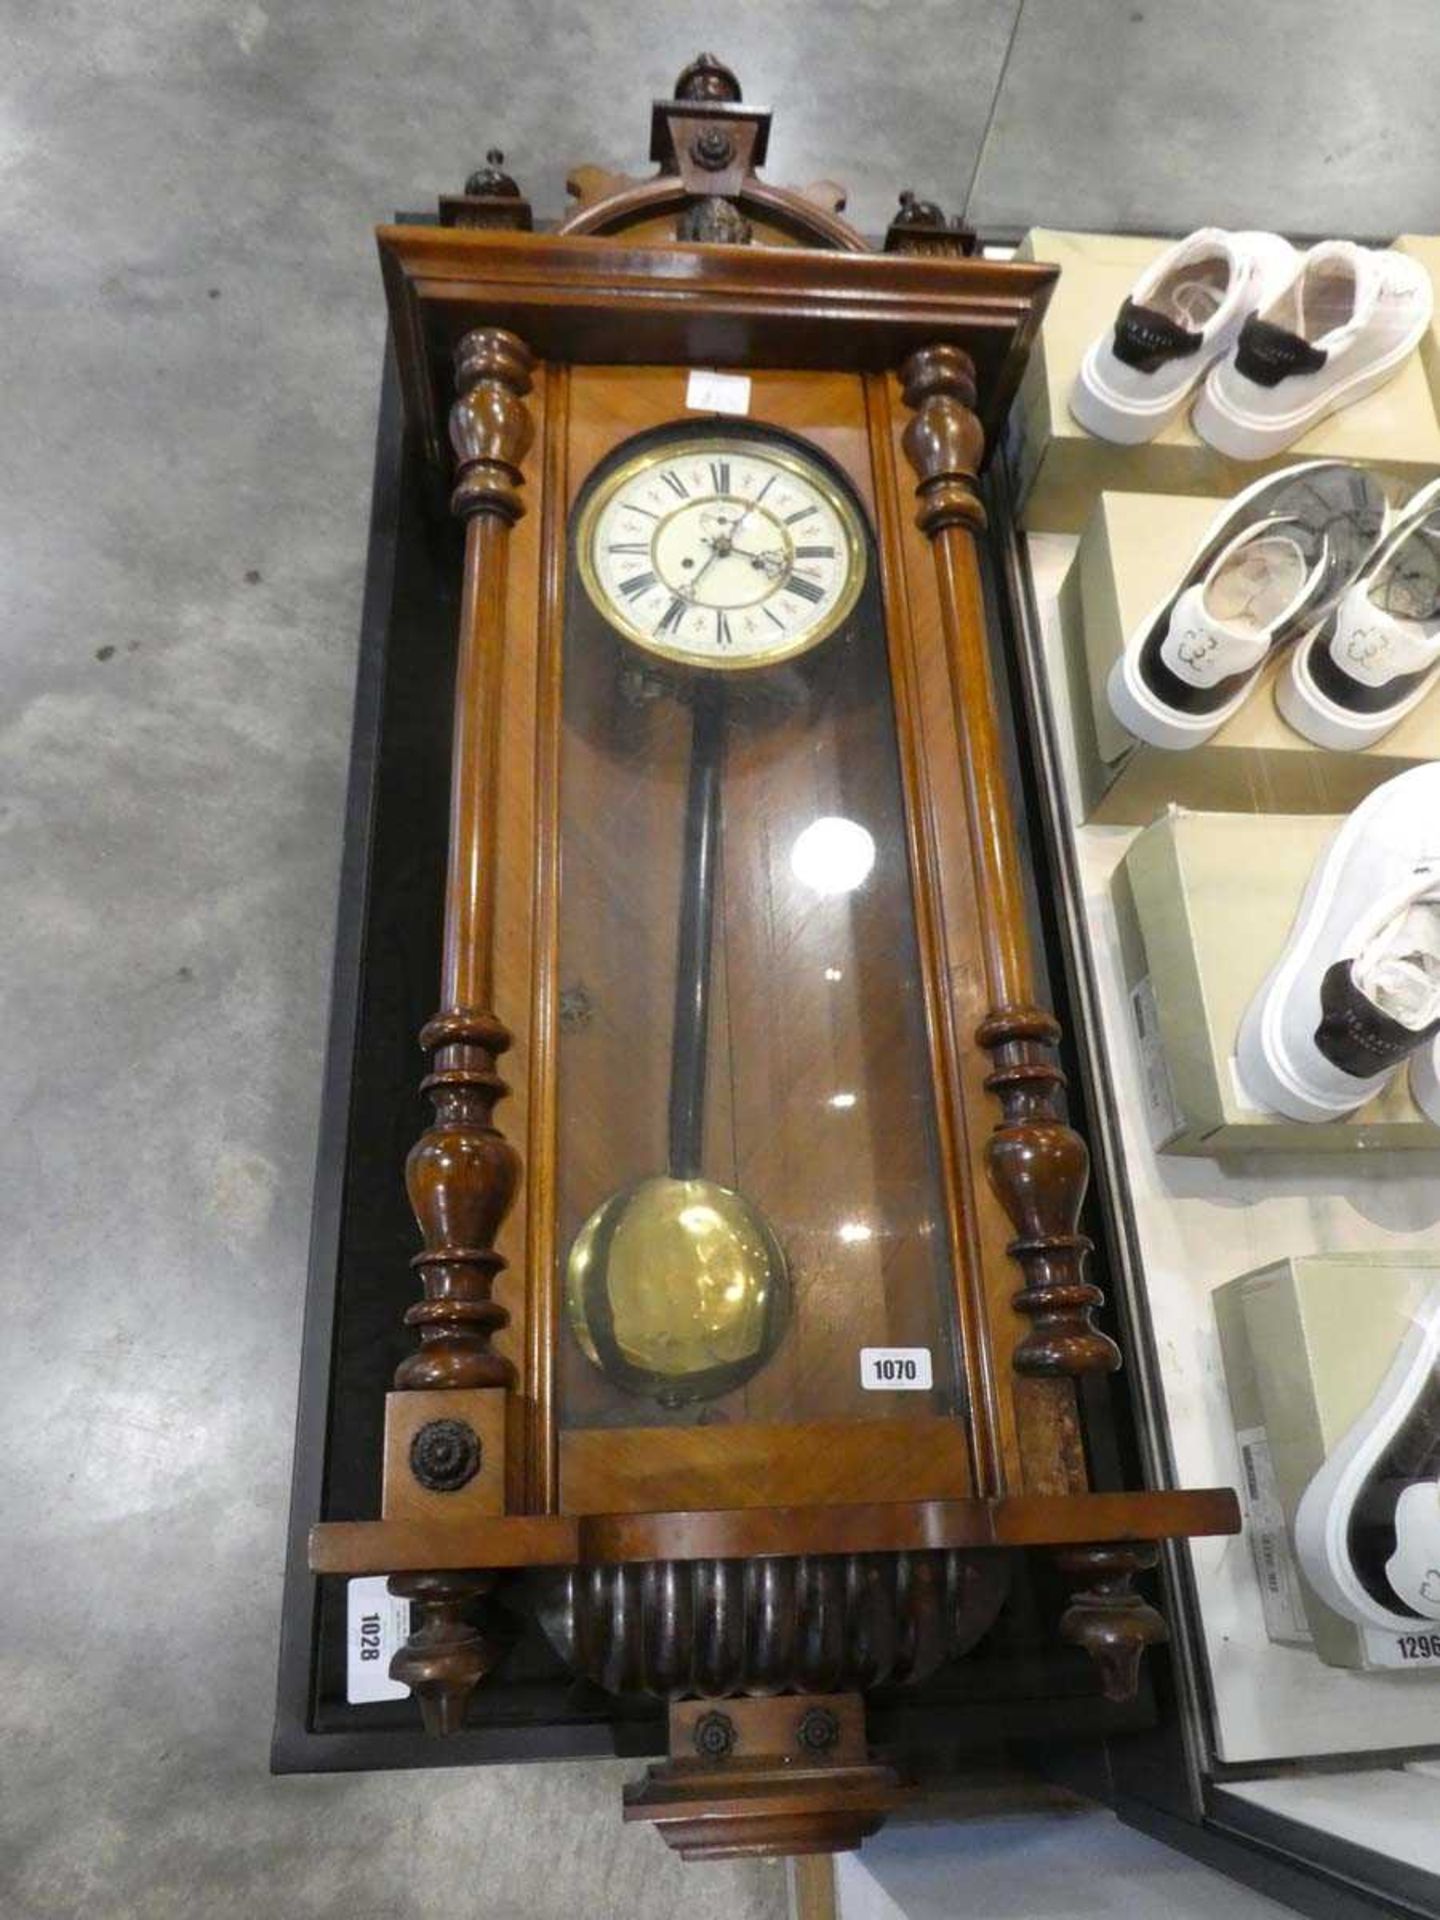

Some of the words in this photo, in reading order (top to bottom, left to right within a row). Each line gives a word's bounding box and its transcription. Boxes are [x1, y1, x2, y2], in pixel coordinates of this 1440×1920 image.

[873, 1359, 917, 1380] 1070
[360, 1611, 381, 1662] 1028
[1396, 1635, 1440, 1660] 1296
